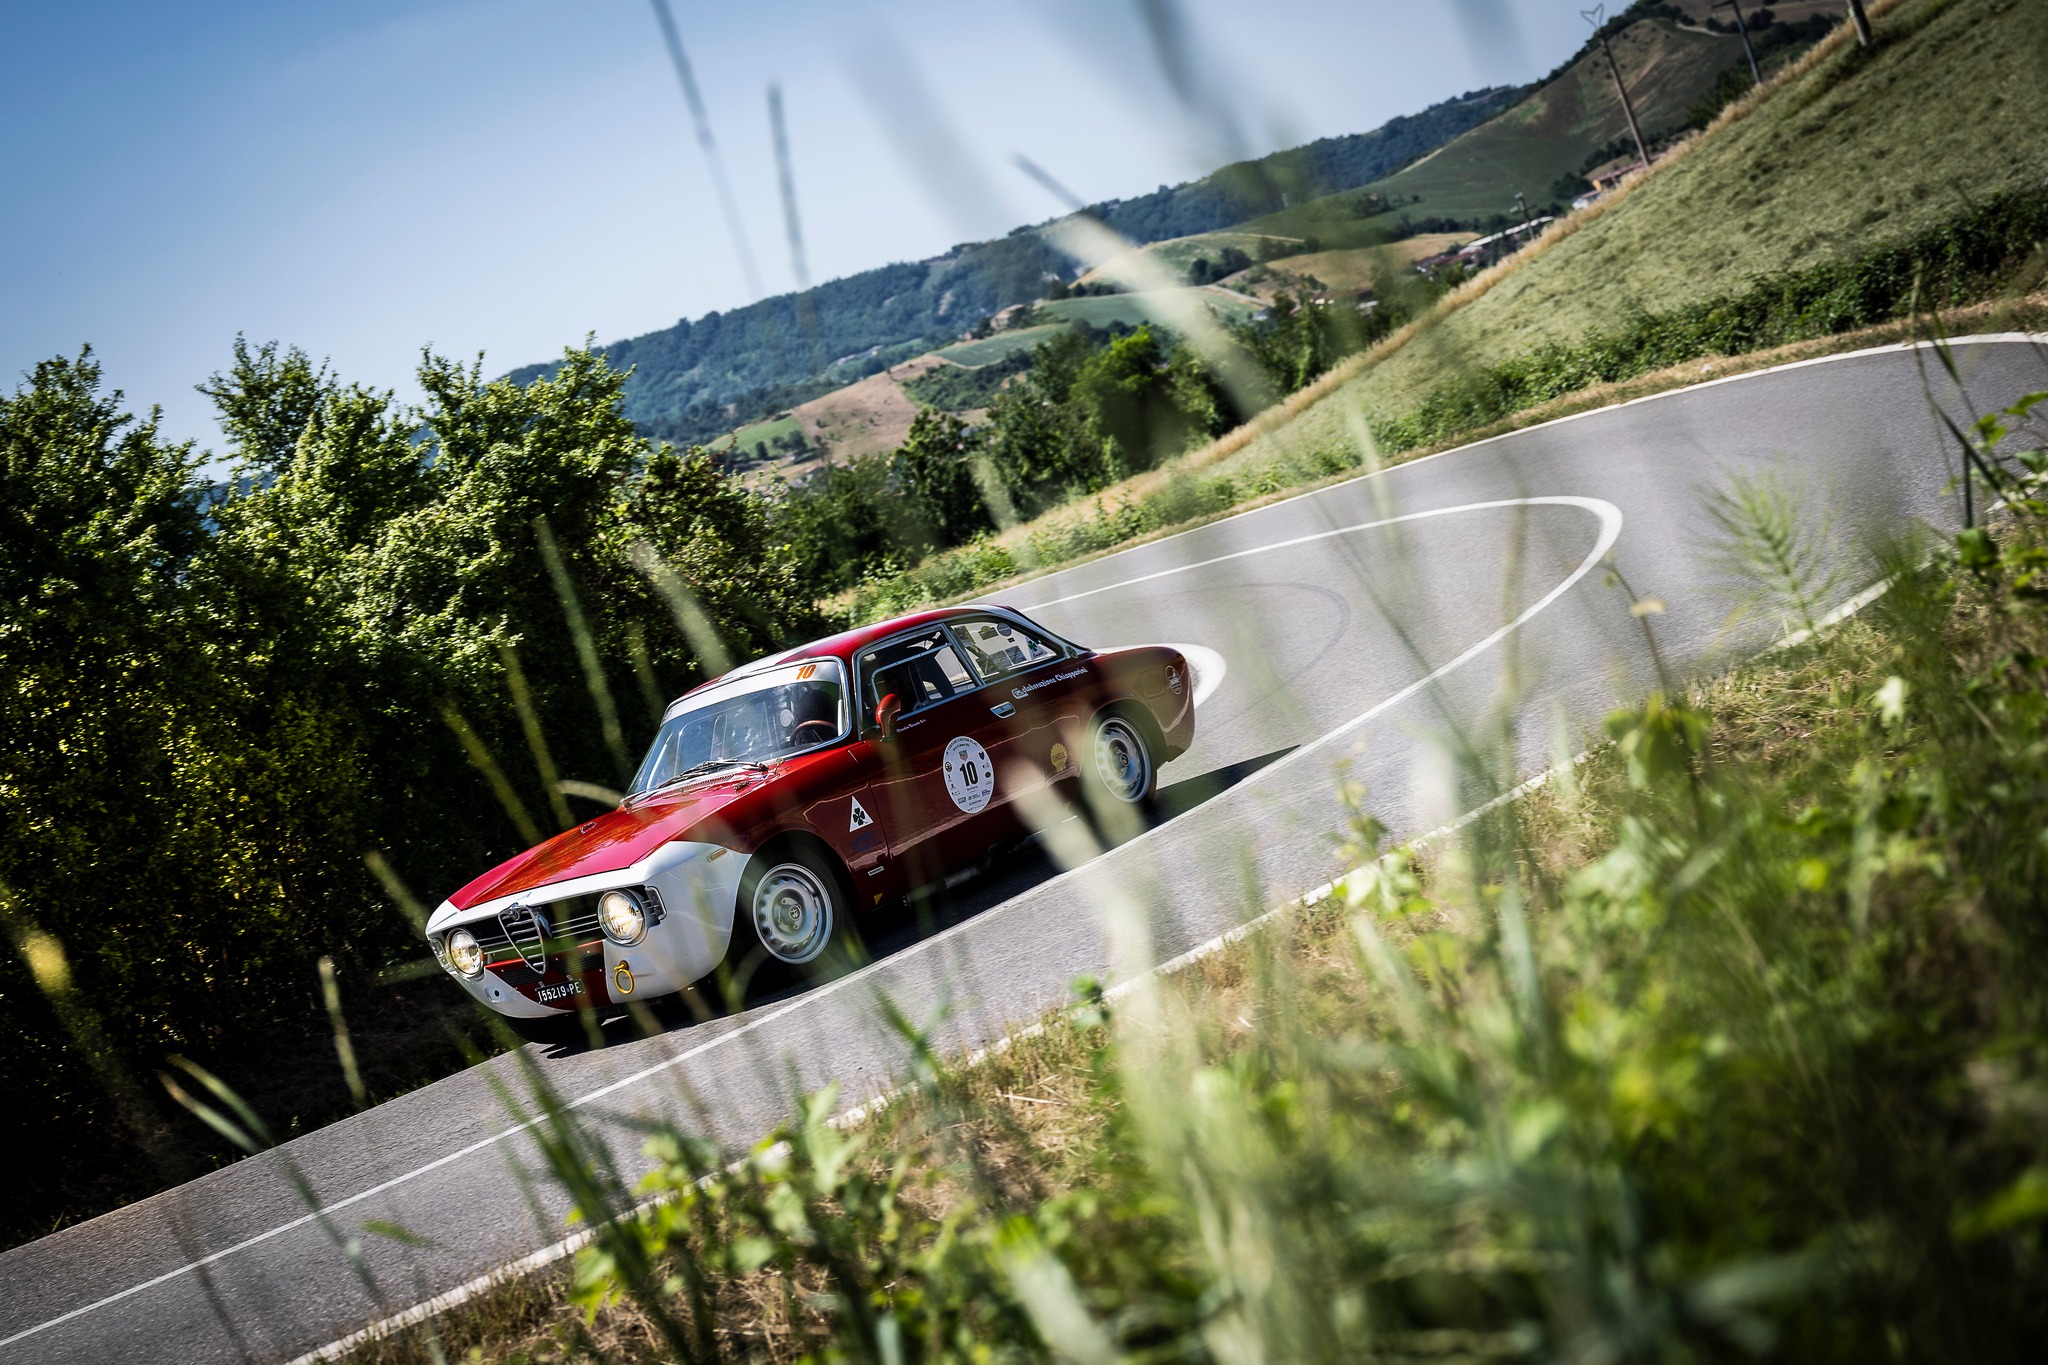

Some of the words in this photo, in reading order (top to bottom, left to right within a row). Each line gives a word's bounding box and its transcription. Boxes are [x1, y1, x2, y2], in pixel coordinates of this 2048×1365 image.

[796, 664, 817, 680] 10
[960, 761, 978, 786] 10
[538, 986, 567, 1002] 155219
[569, 982, 582, 994] PE
